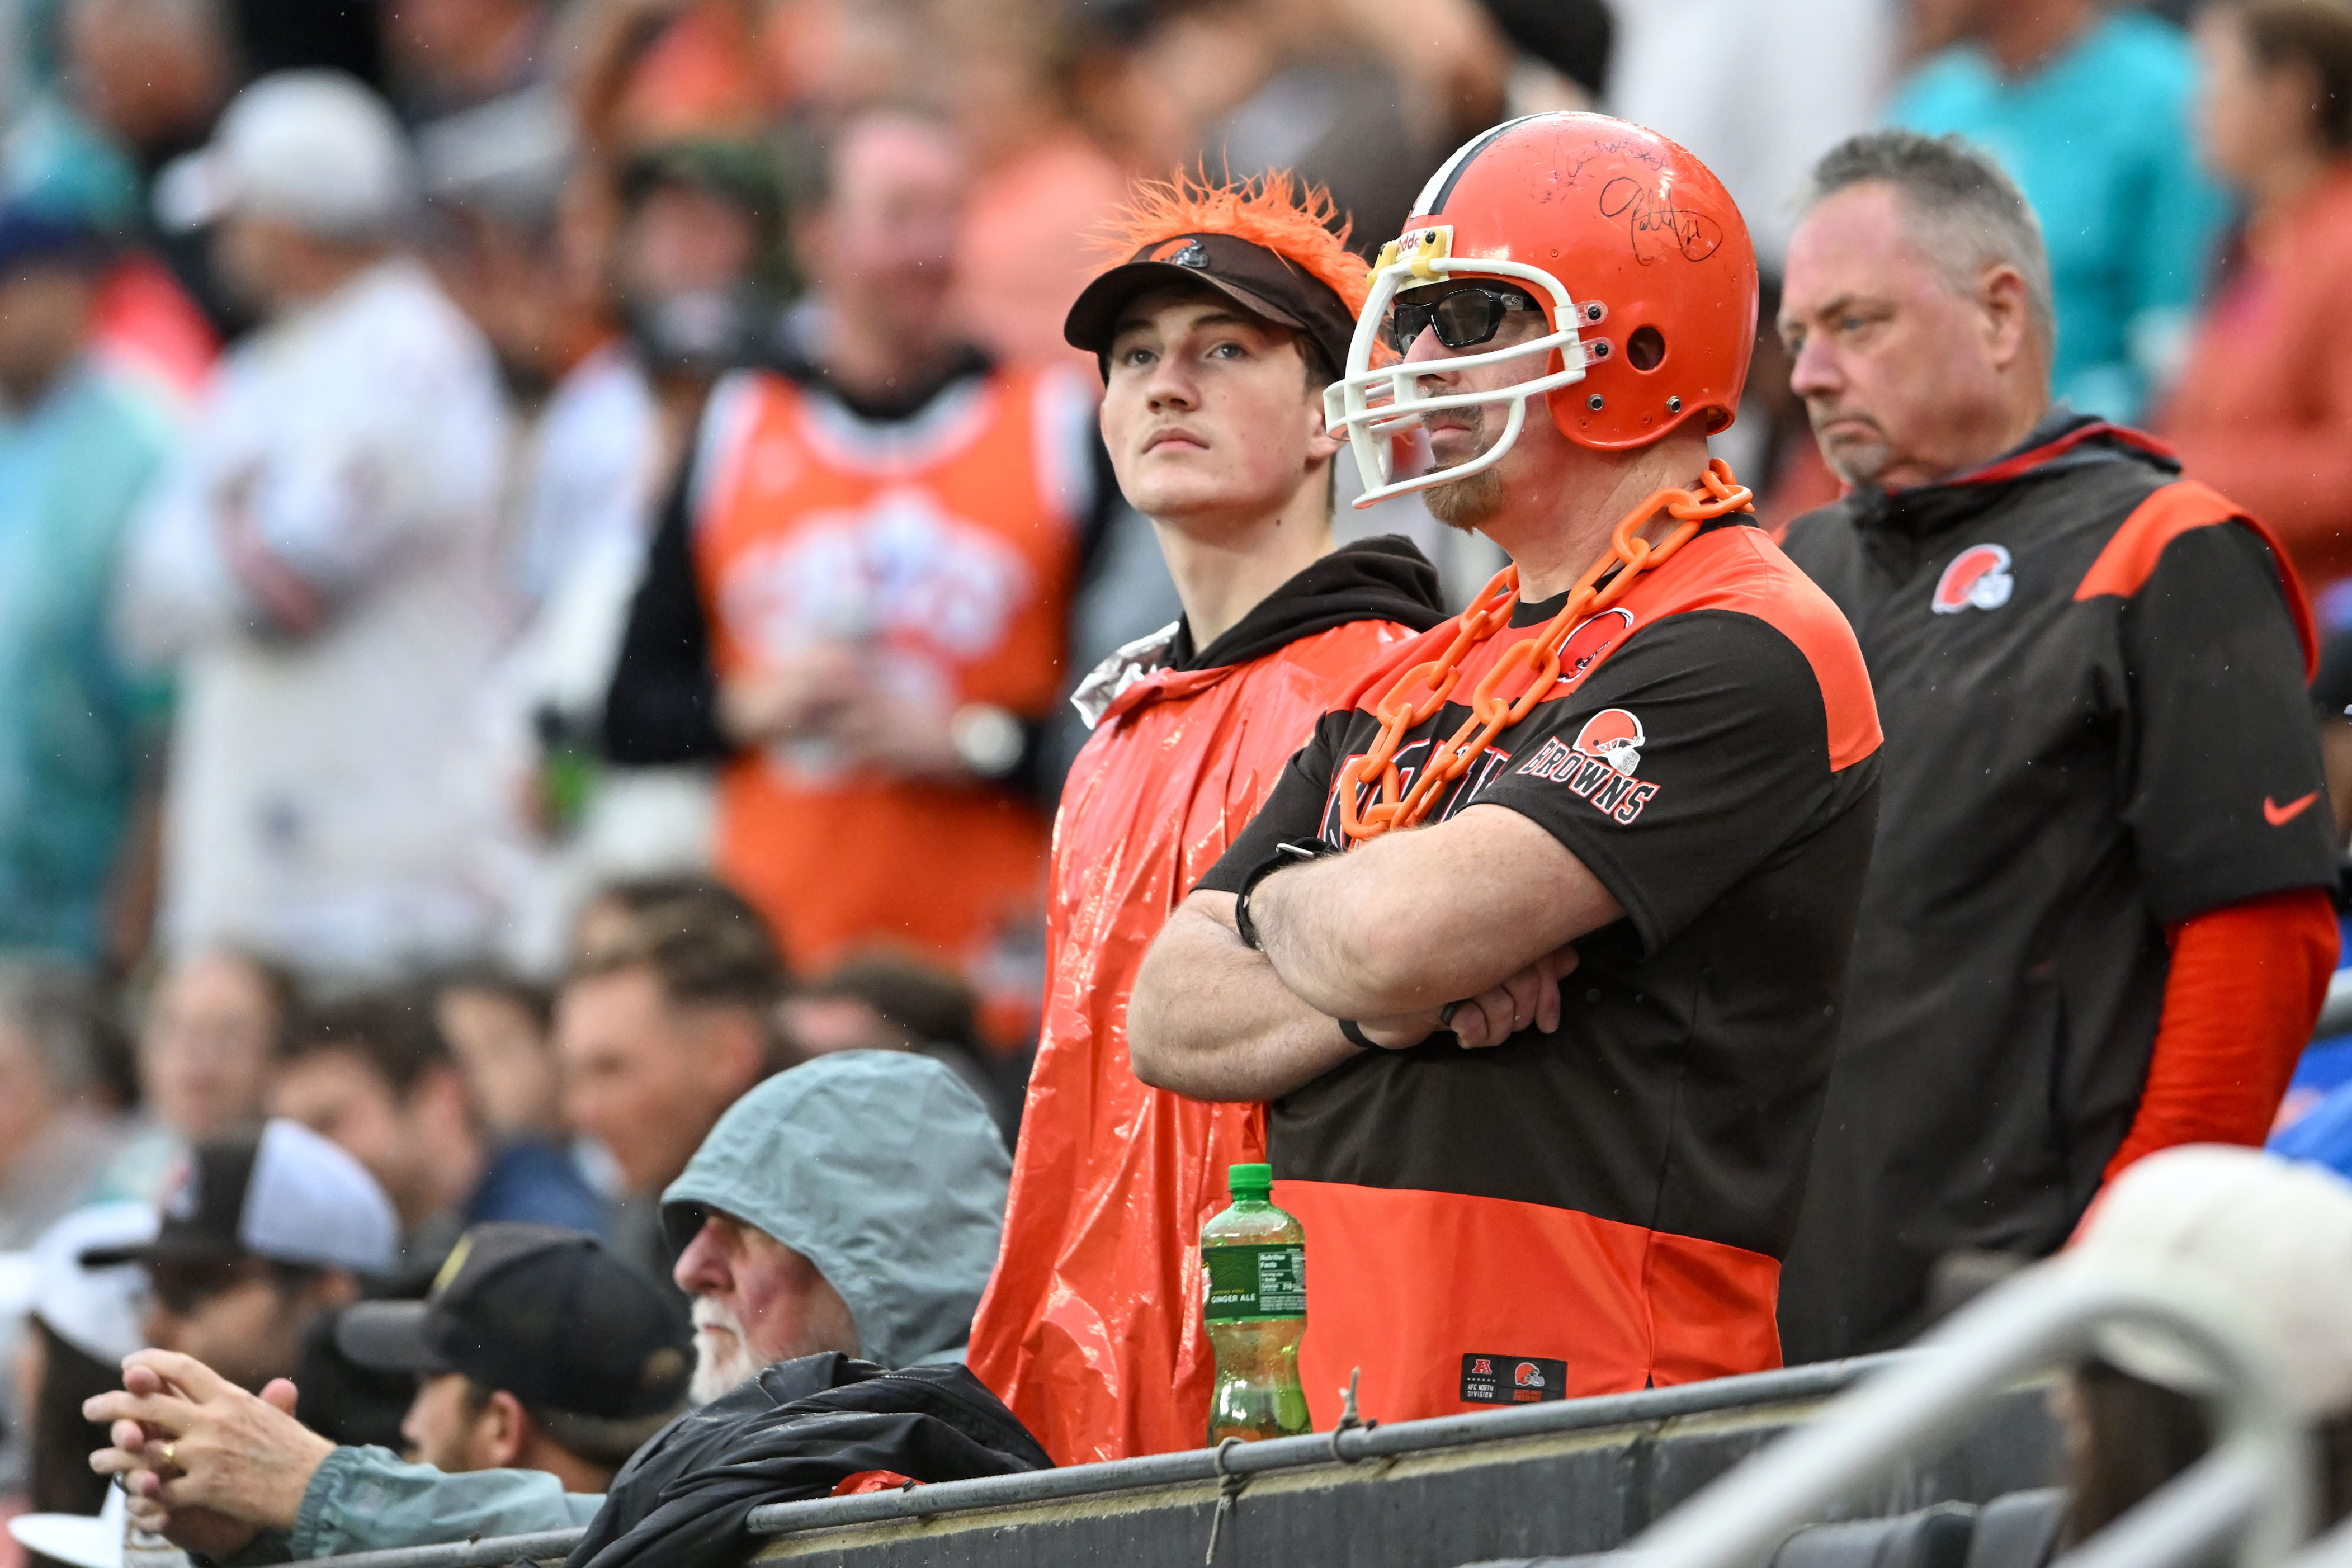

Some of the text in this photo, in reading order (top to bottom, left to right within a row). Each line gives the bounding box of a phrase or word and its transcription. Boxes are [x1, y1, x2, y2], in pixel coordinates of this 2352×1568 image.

[1515, 736, 1661, 825] BROWNS
[1211, 1293, 1256, 1304] GINGER ALE
